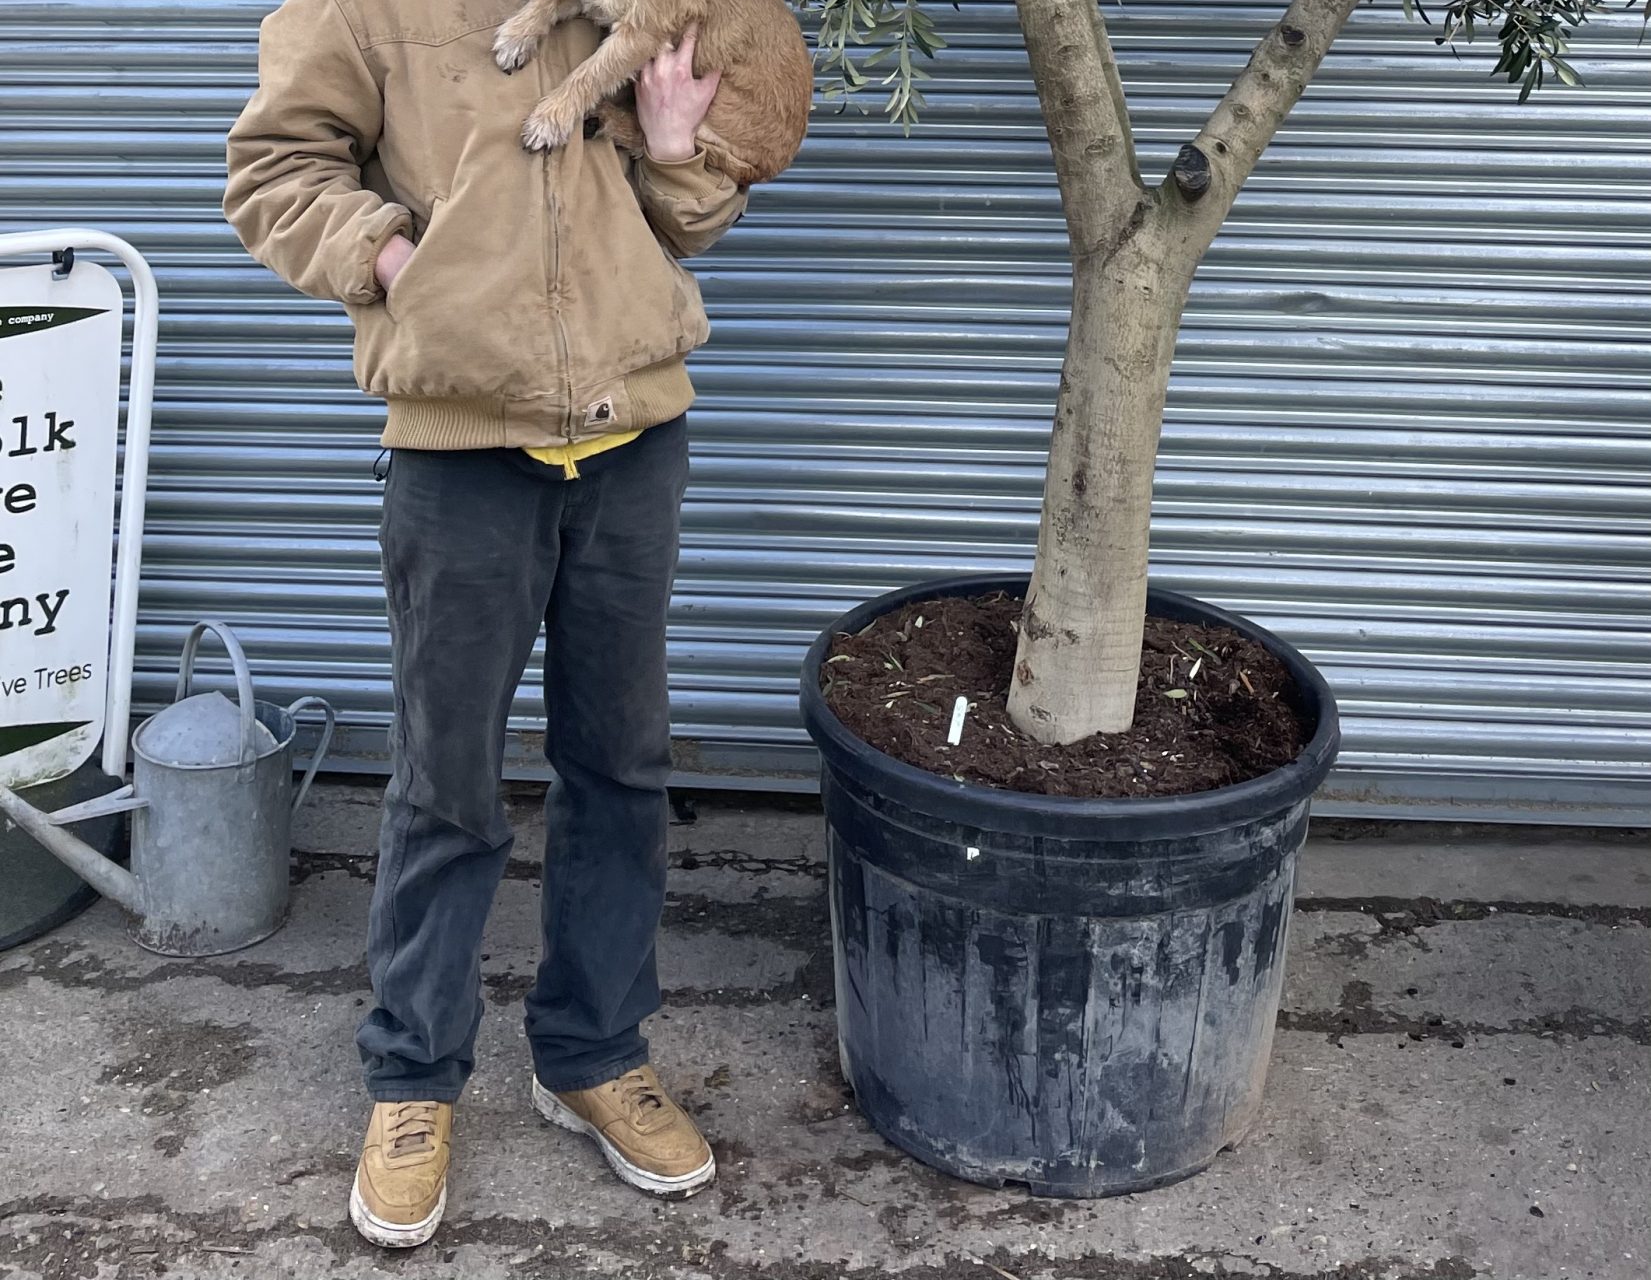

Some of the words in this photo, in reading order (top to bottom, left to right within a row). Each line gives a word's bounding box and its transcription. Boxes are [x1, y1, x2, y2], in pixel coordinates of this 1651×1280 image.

[8, 313, 55, 325] company
[0, 411, 77, 458] lk
[0, 483, 37, 514] e
[0, 589, 70, 636] ny
[34, 663, 92, 690] Trees
